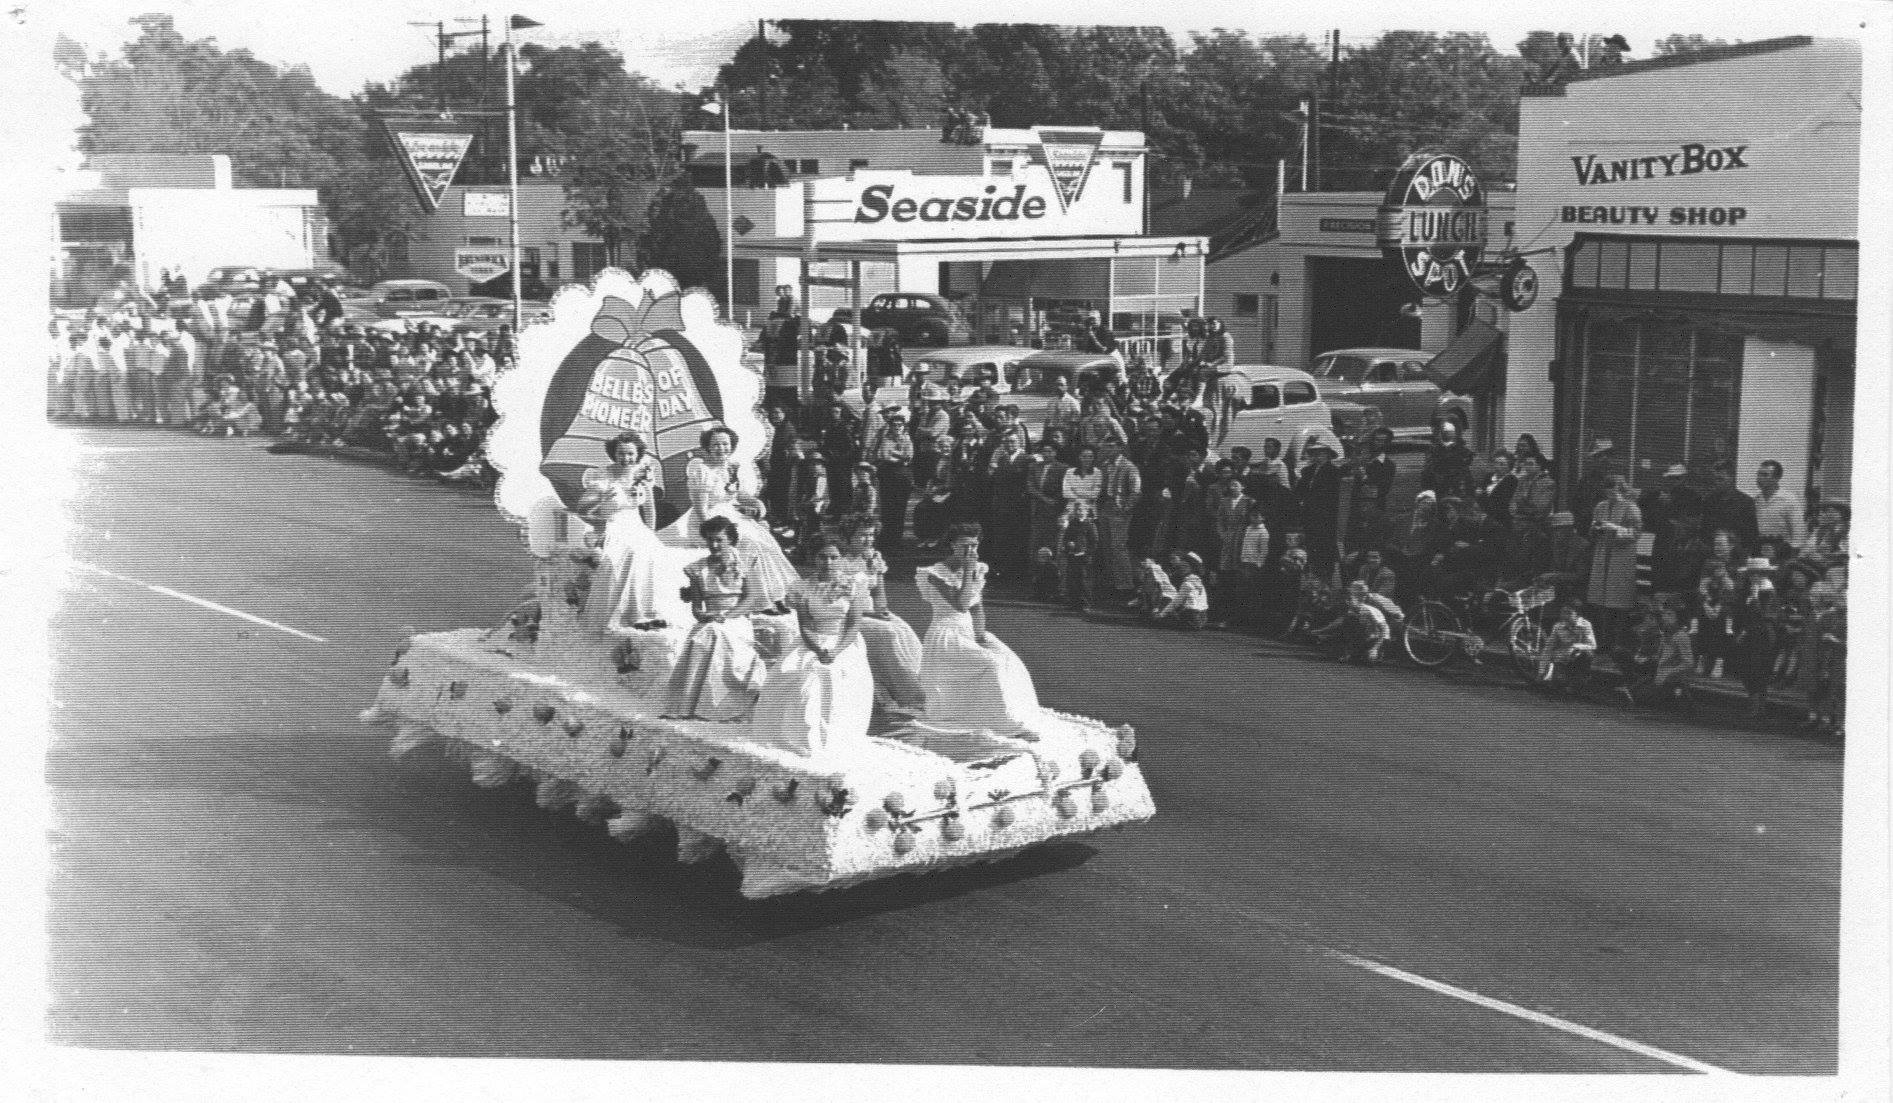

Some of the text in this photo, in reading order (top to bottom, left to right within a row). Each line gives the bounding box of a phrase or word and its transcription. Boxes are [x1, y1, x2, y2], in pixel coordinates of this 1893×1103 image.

[1570, 143, 1749, 187] VANITY BOX
[853, 184, 1047, 223] Seaside
[1561, 205, 1748, 226] BEAUTY SHOP
[1409, 210, 1477, 243] LUNCH
[1411, 250, 1471, 292] SPOT
[657, 366, 684, 391] OF
[580, 388, 693, 433] PIONEER DAY
